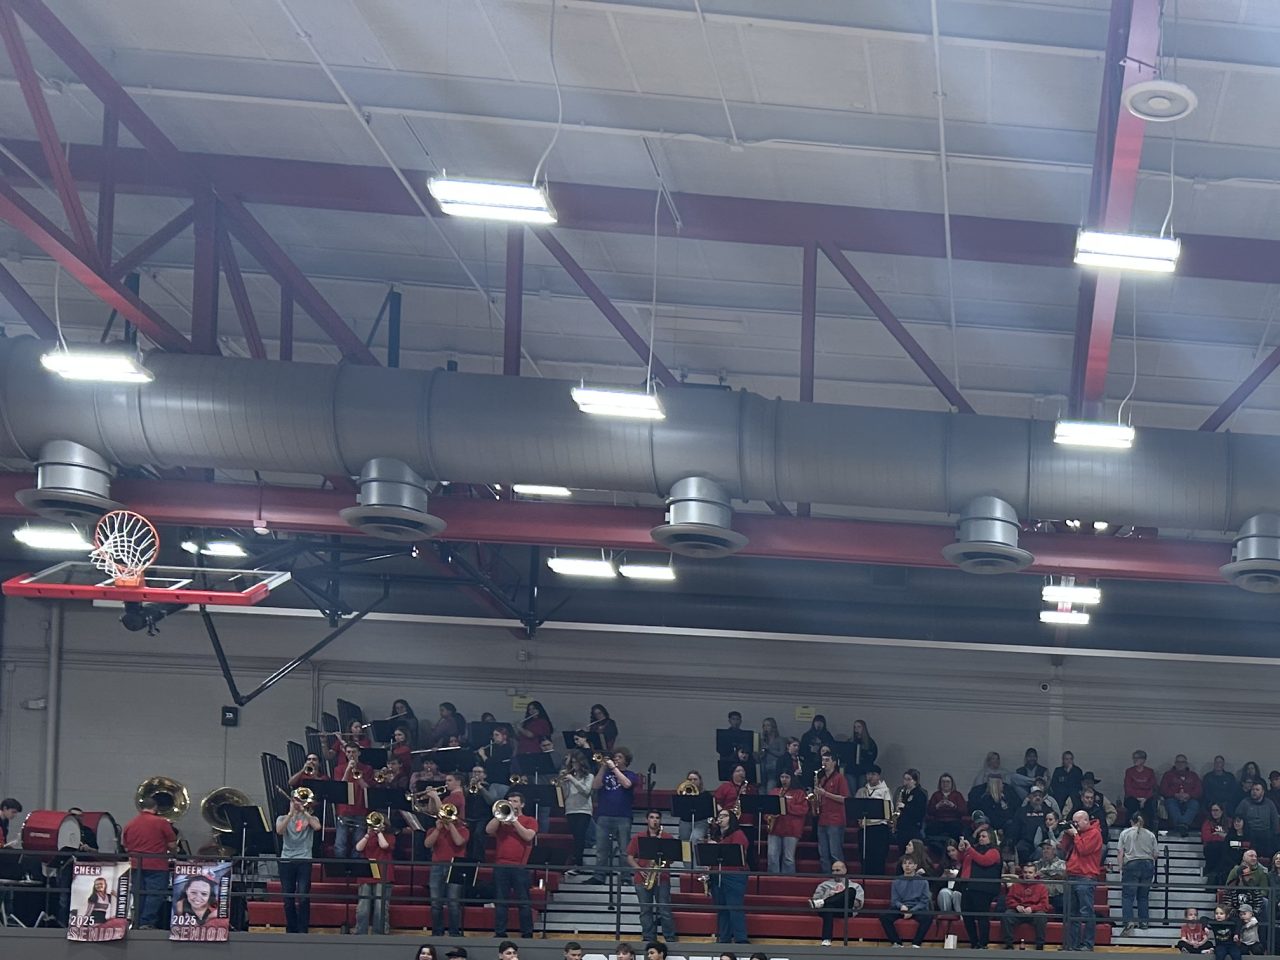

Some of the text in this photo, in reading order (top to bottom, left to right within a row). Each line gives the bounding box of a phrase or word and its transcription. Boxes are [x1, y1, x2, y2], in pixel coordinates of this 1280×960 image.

[74, 865, 101, 876] CHEER
[175, 865, 202, 876] CHEER
[70, 915, 96, 927] 2025
[172, 915, 197, 926] 2025
[67, 926, 125, 941] SENIOR
[171, 926, 228, 941] SENIOR
